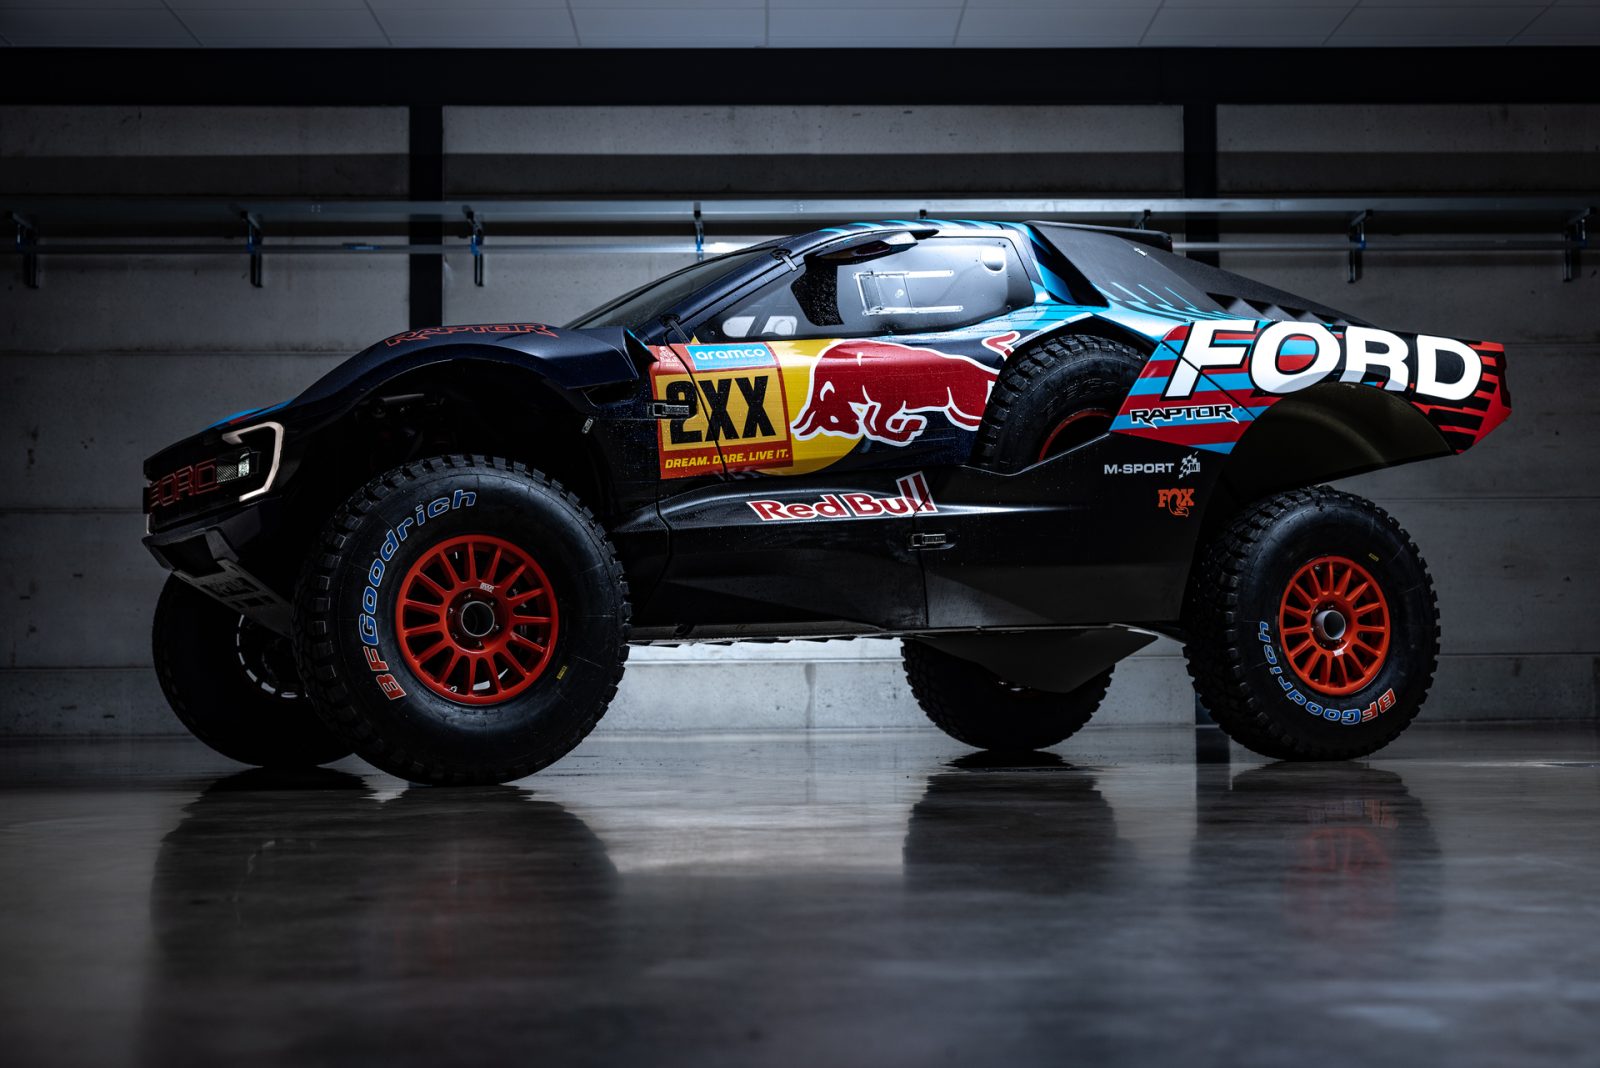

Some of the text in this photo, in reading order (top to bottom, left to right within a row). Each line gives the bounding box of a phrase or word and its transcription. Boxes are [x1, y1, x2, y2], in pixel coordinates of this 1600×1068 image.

[384, 323, 560, 347] RAPTOR
[695, 348, 766, 361] aramco
[1164, 320, 1482, 400] FORD
[666, 375, 777, 445] 2XX
[1130, 403, 1240, 430] RAPTOR
[665, 448, 789, 469] DREAM. DARE. LIVE IT.
[1157, 487, 1196, 518] FOX
[358, 489, 477, 701] BFGoodrich
[1257, 620, 1397, 726] BFGoodrich
